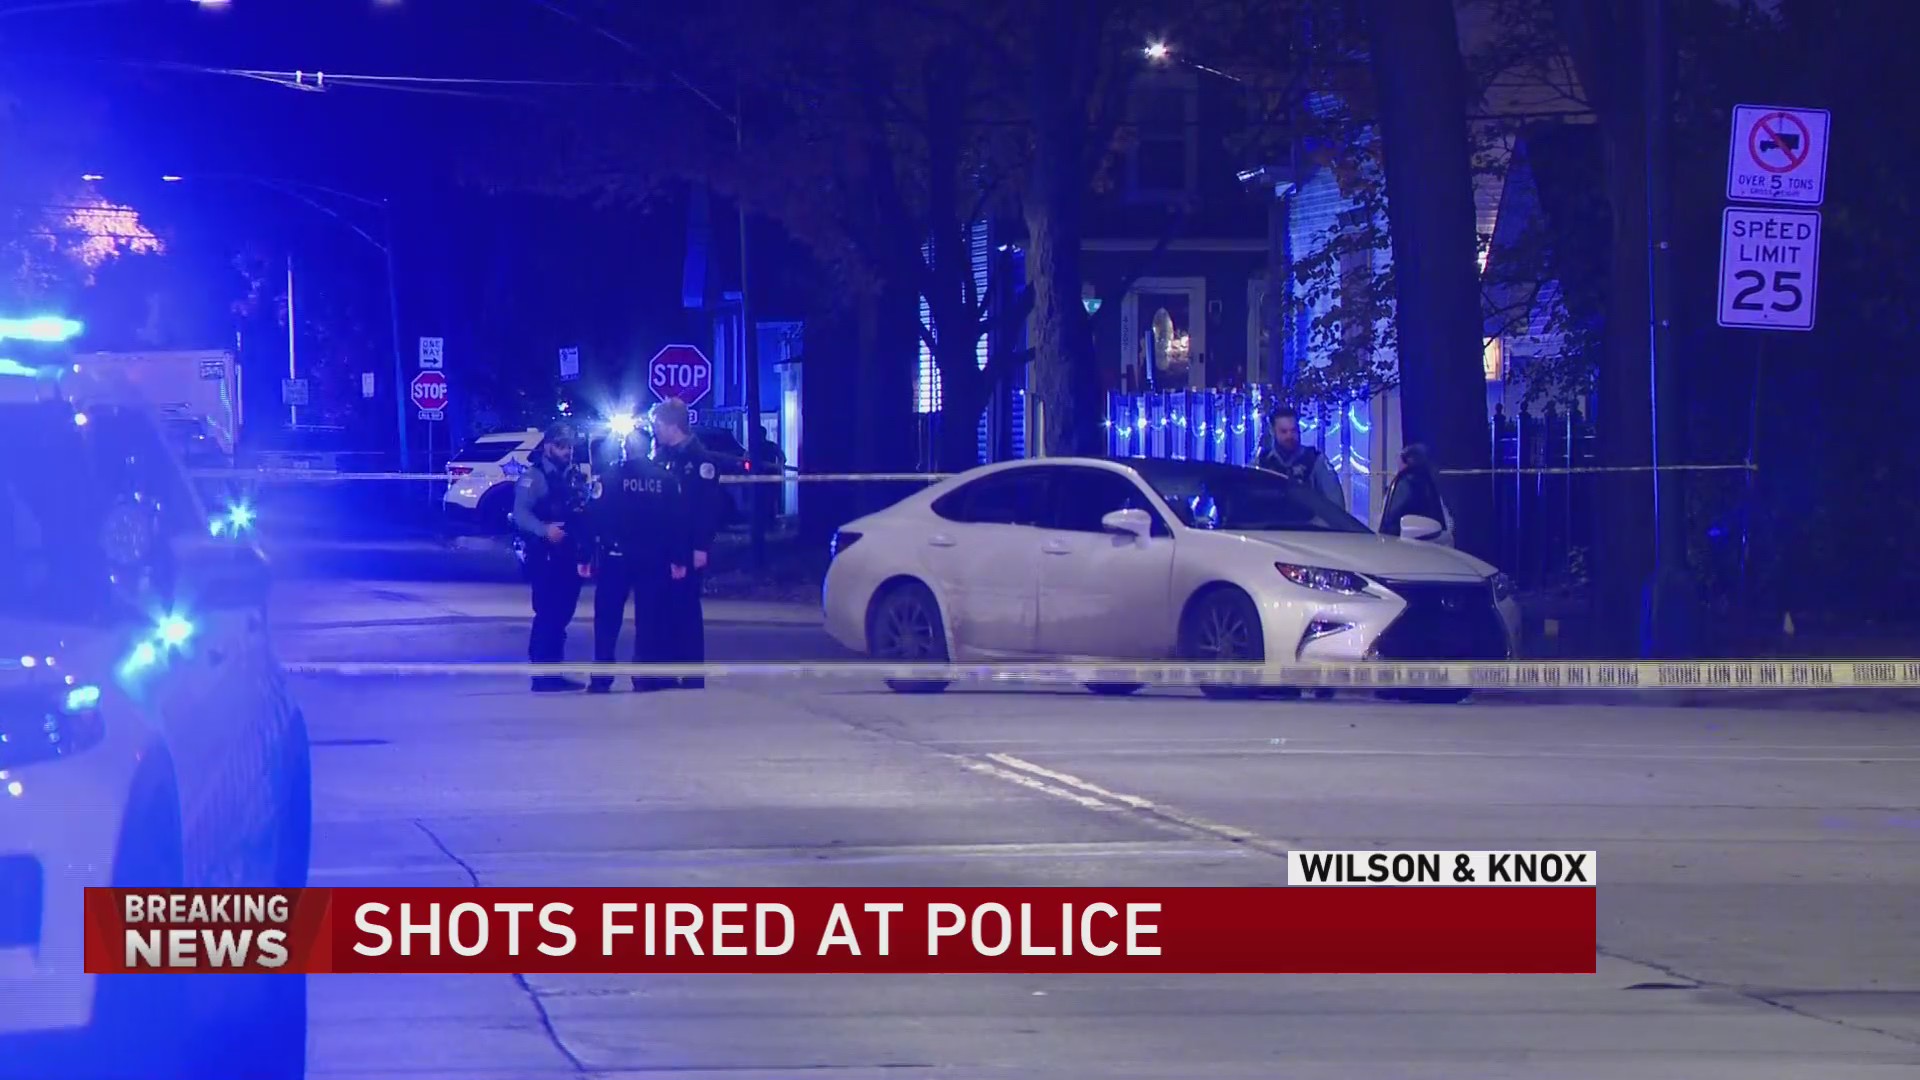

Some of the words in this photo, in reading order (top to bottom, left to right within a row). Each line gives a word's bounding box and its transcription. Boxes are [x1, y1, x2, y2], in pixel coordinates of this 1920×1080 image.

[1738, 174, 1765, 187] OVER
[1770, 174, 1783, 190] 5
[1788, 178, 1814, 190] TONS
[1732, 219, 1811, 241] SPEED
[1740, 243, 1801, 264] LIMIT
[1732, 269, 1803, 313] 25
[422, 340, 440, 348] ONE
[422, 348, 440, 356] WAY
[653, 364, 707, 387] STOP
[414, 383, 448, 399] STOP
[623, 478, 662, 493] POLICE
